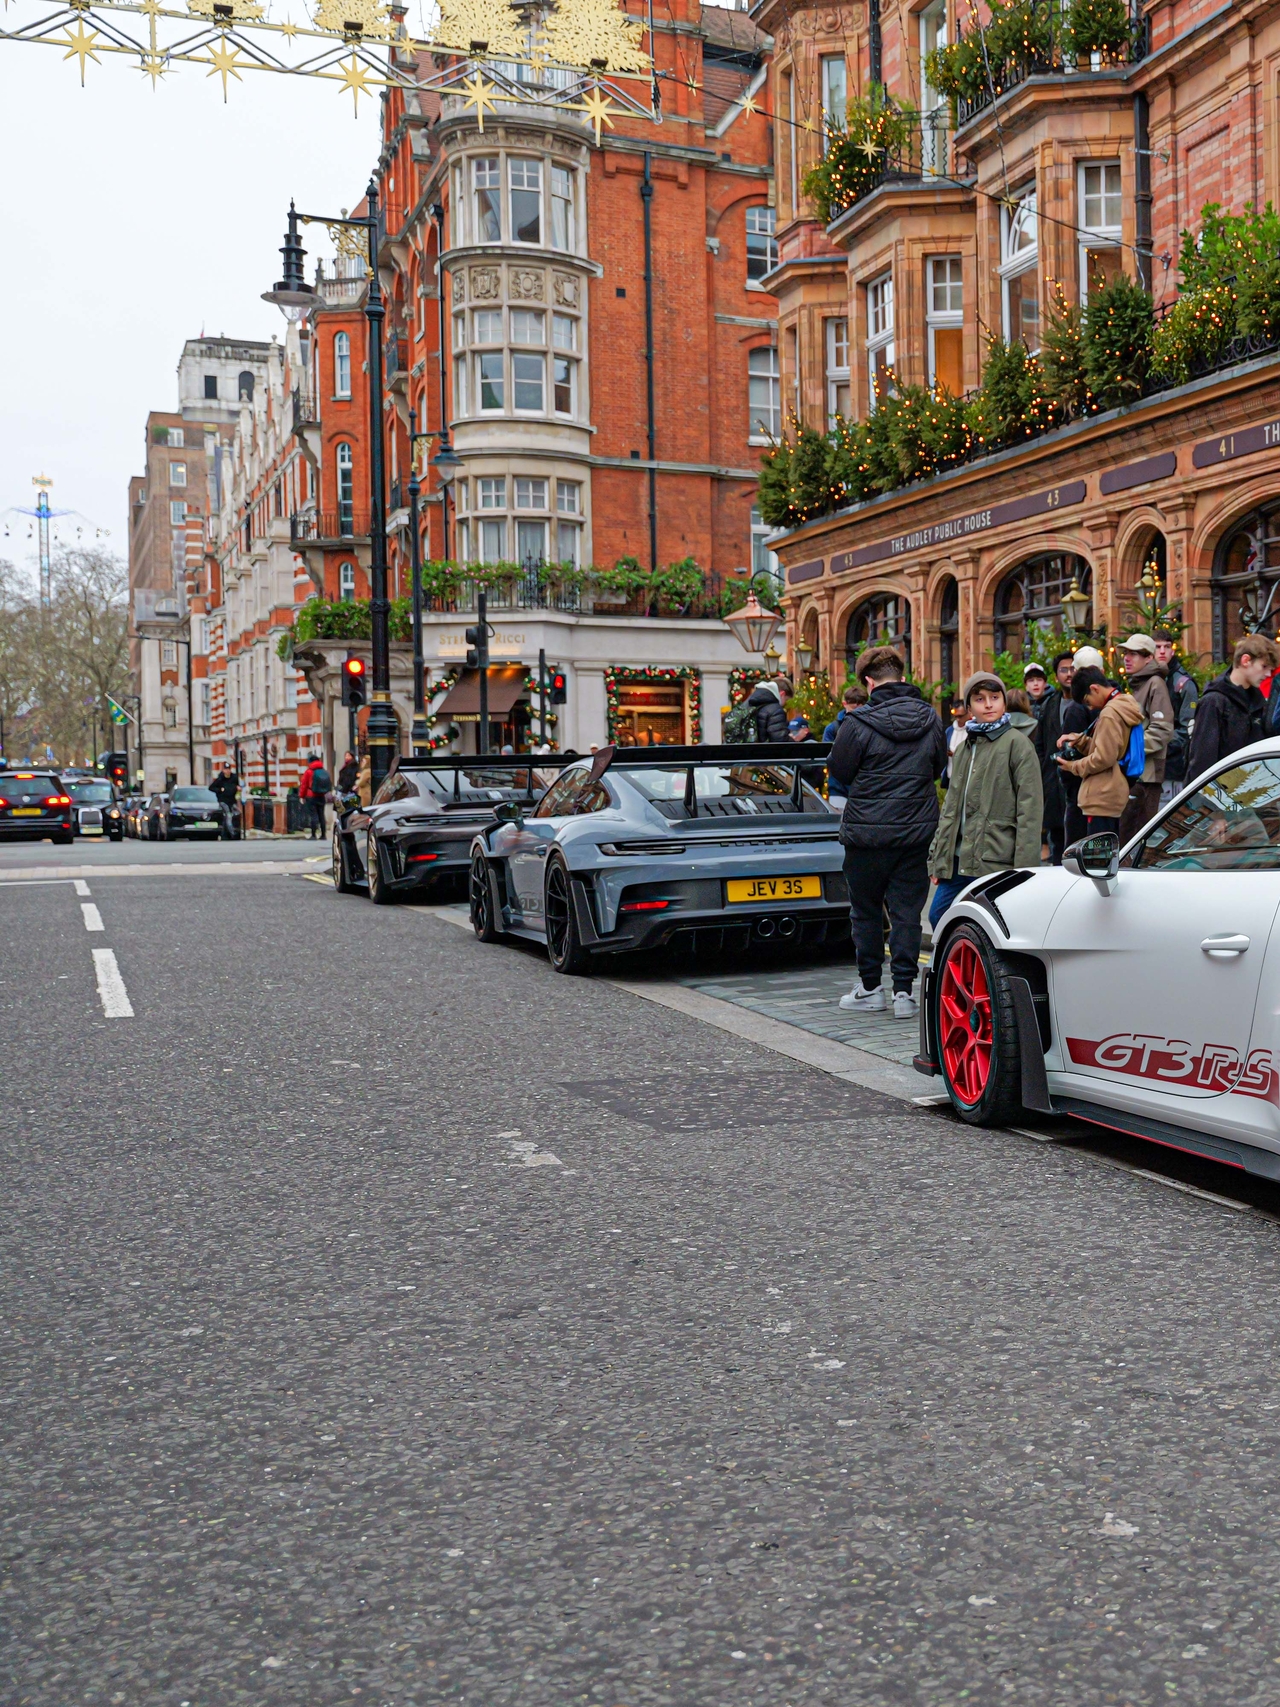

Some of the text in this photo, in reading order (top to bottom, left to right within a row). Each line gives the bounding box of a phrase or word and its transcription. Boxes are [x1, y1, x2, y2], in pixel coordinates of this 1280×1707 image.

[1219, 436, 1235, 456] 41
[891, 536, 904, 553] THE
[906, 527, 933, 549] AUDLEY
[934, 519, 963, 539] PUBLIC
[964, 510, 992, 530] HOUSE
[1046, 489, 1060, 507] 43
[494, 631, 526, 644] RICCI
[747, 880, 803, 896] JEV 3S
